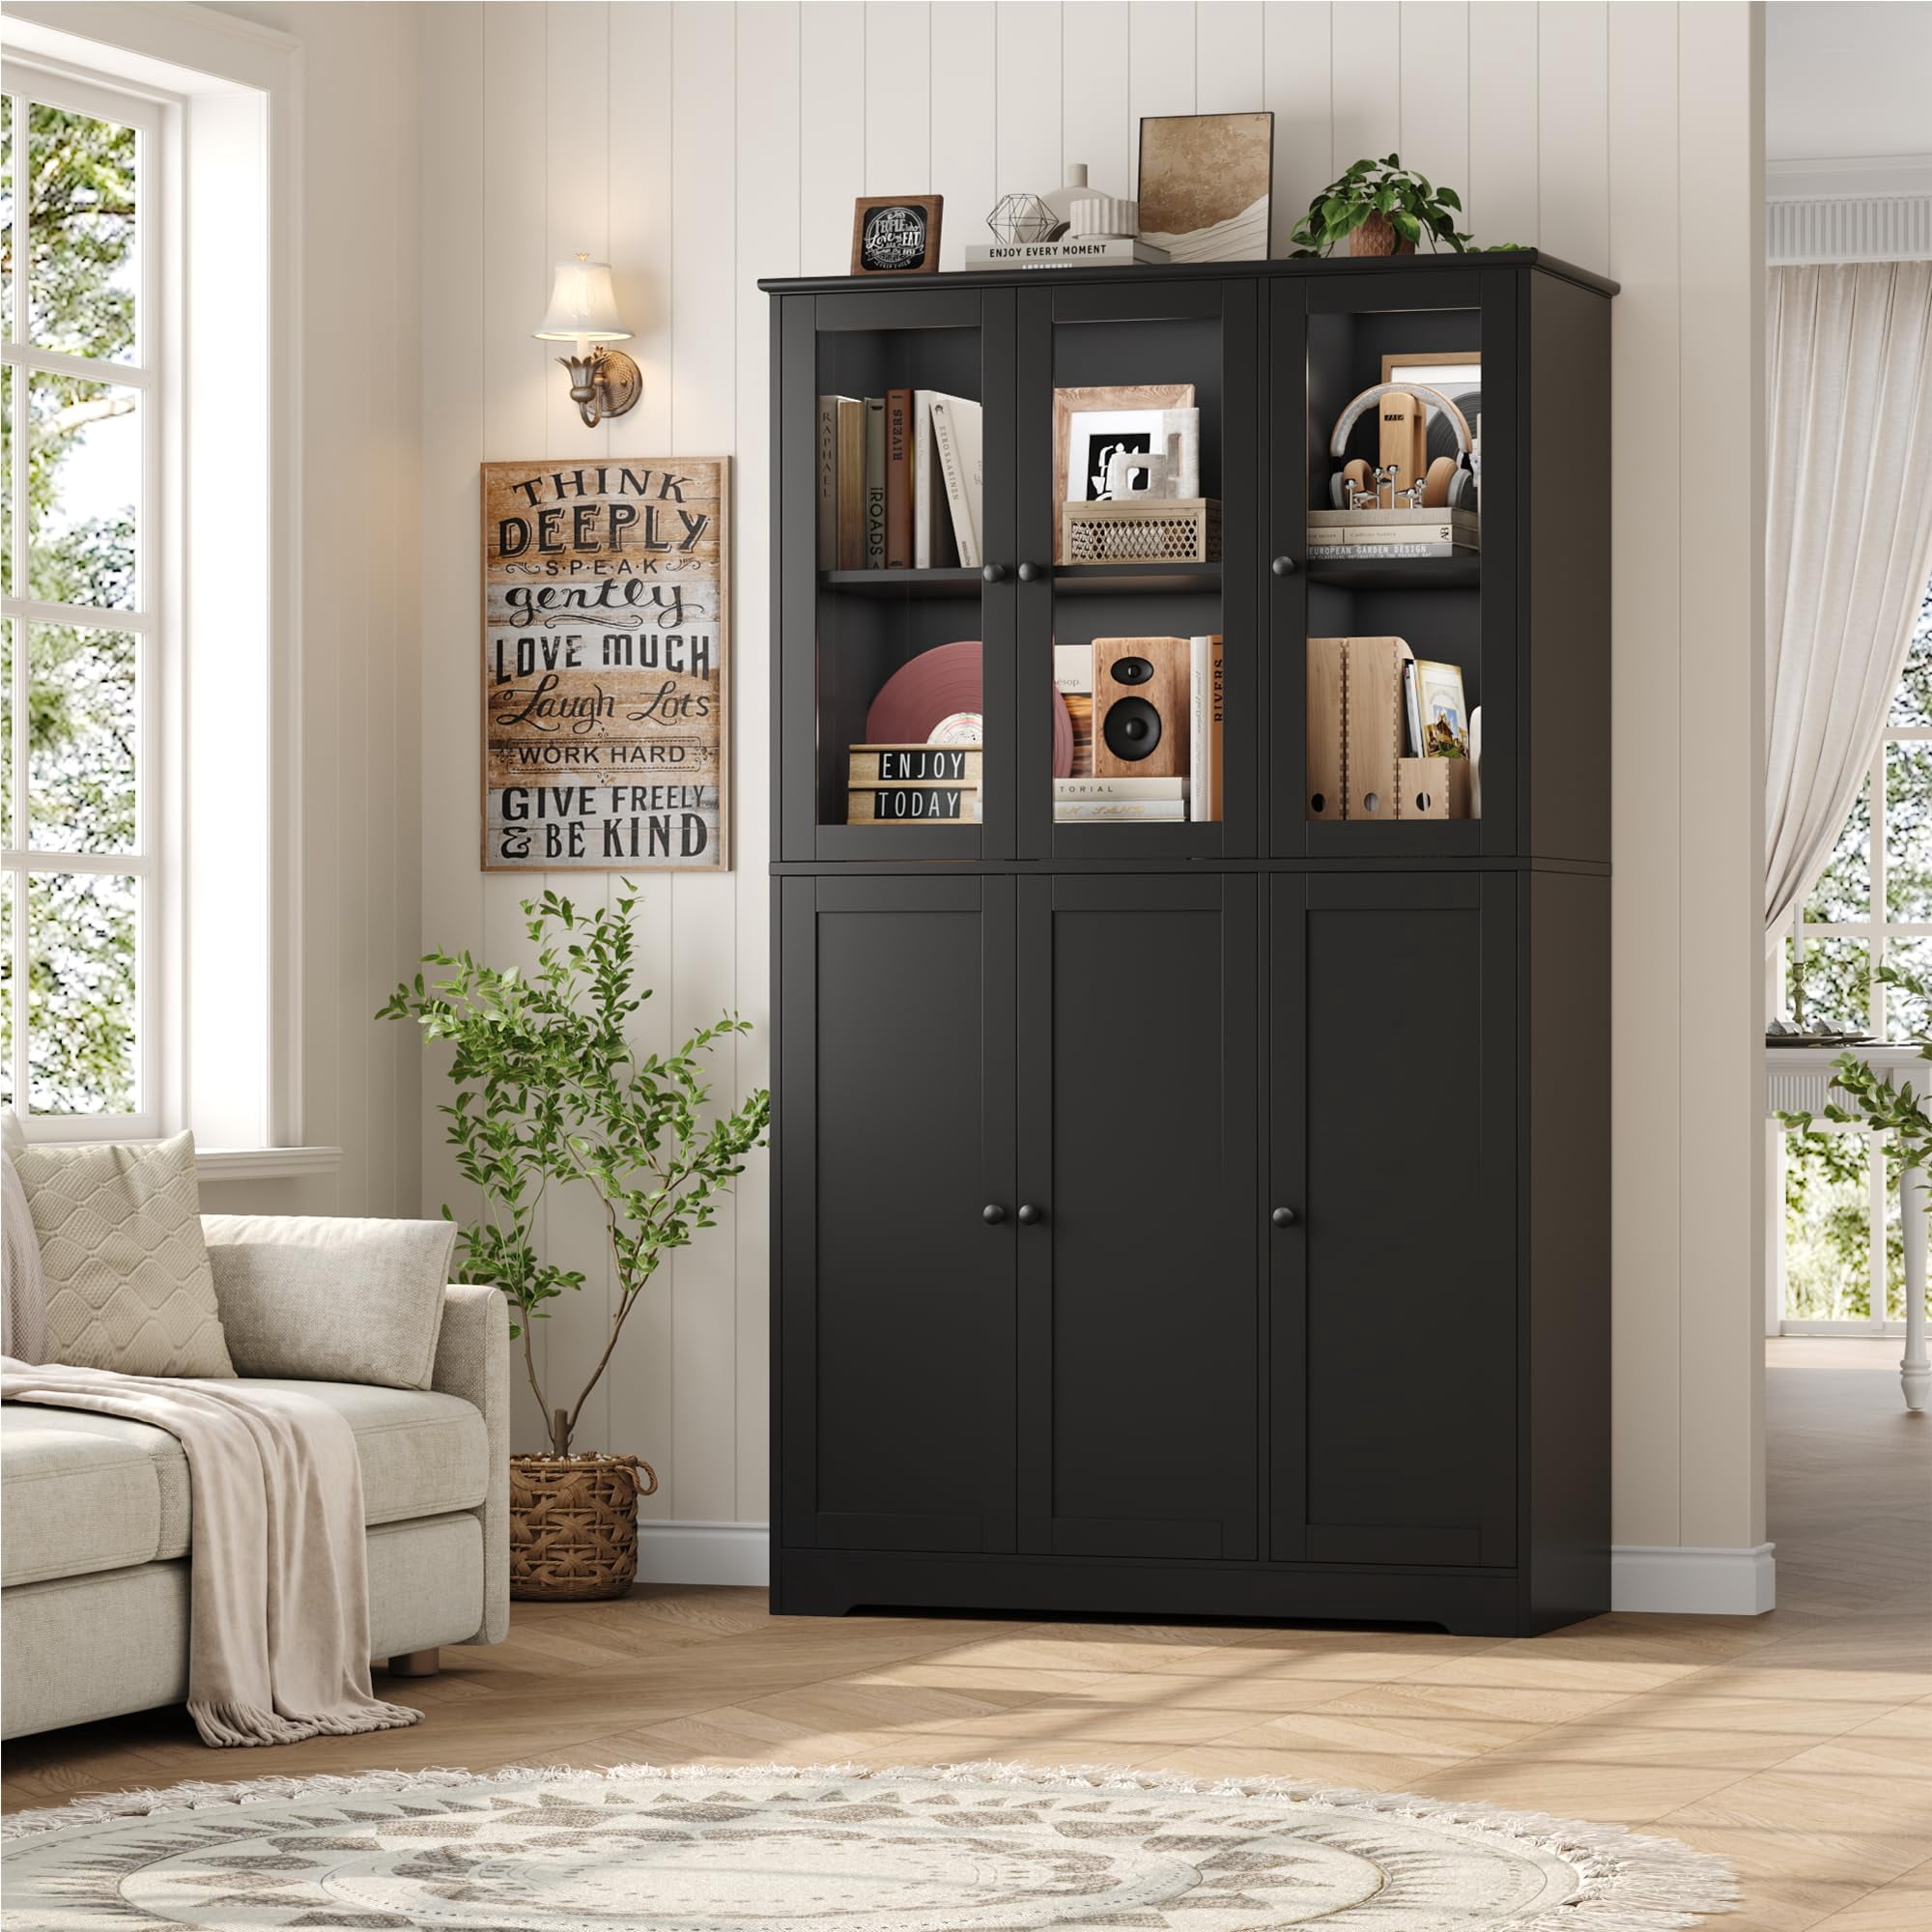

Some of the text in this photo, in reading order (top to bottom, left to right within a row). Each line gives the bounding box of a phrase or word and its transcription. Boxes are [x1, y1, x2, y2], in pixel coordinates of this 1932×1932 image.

[989, 244, 1107, 258] ENJOY EVERY MOMENT
[822, 412, 833, 497] RAPHAEL
[893, 409, 903, 461] RIVERS
[512, 468, 695, 508] THINK
[498, 503, 712, 558] DEEPLY
[1356, 546, 1389, 554] GARDEN
[1394, 544, 1427, 554] DESIGN
[505, 579, 704, 629] gently
[496, 634, 710, 686] LOVE MUCH
[494, 673, 710, 734] Laugh Lots
[1213, 659, 1223, 722] RIVERS
[519, 745, 686, 765] WORK HARD
[882, 752, 963, 779] ENJOY
[501, 785, 706, 821] GIVE FREELY
[878, 791, 959, 817] TODAY
[500, 812, 708, 859] & BE KIND
